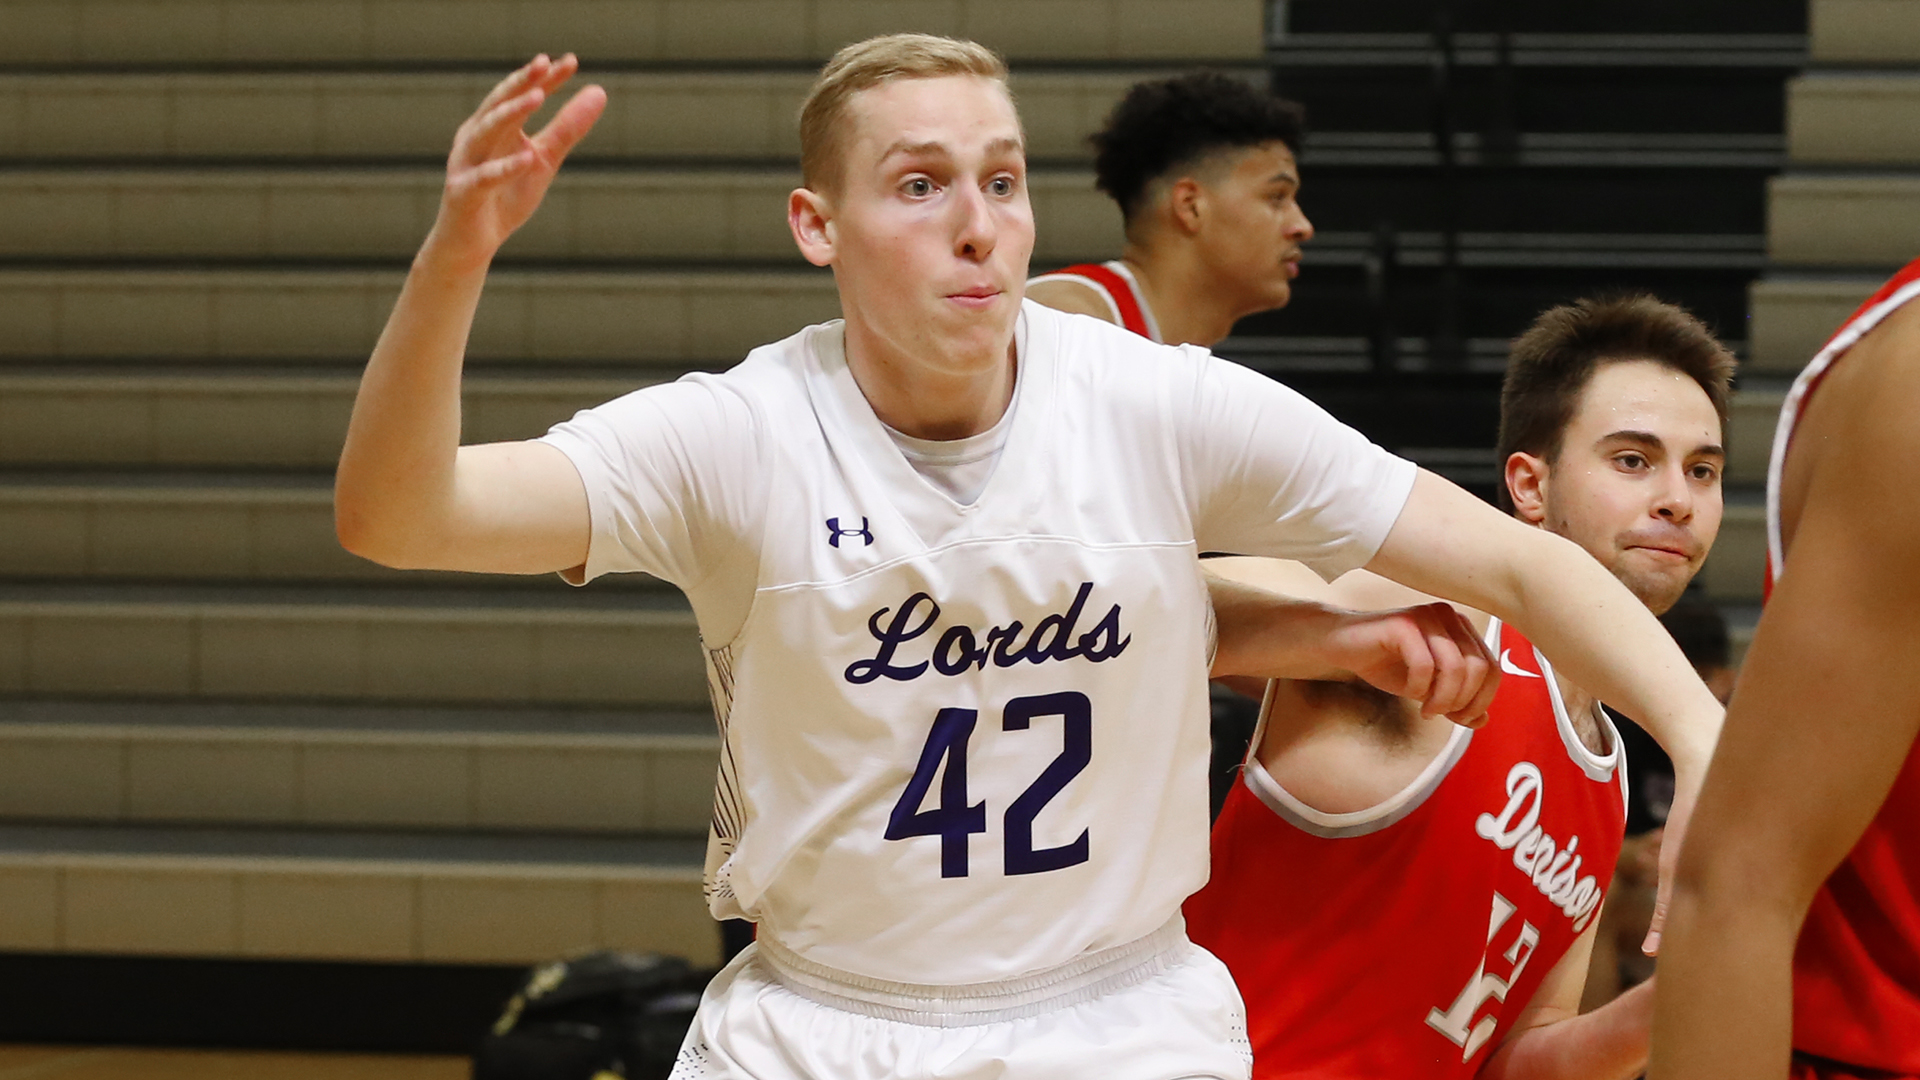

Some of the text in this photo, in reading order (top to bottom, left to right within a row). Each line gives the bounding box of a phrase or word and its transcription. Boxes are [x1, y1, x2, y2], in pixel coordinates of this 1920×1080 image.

[844, 581, 1131, 684] Lords
[884, 691, 1092, 878] 42
[1424, 890, 1540, 1064] 12
